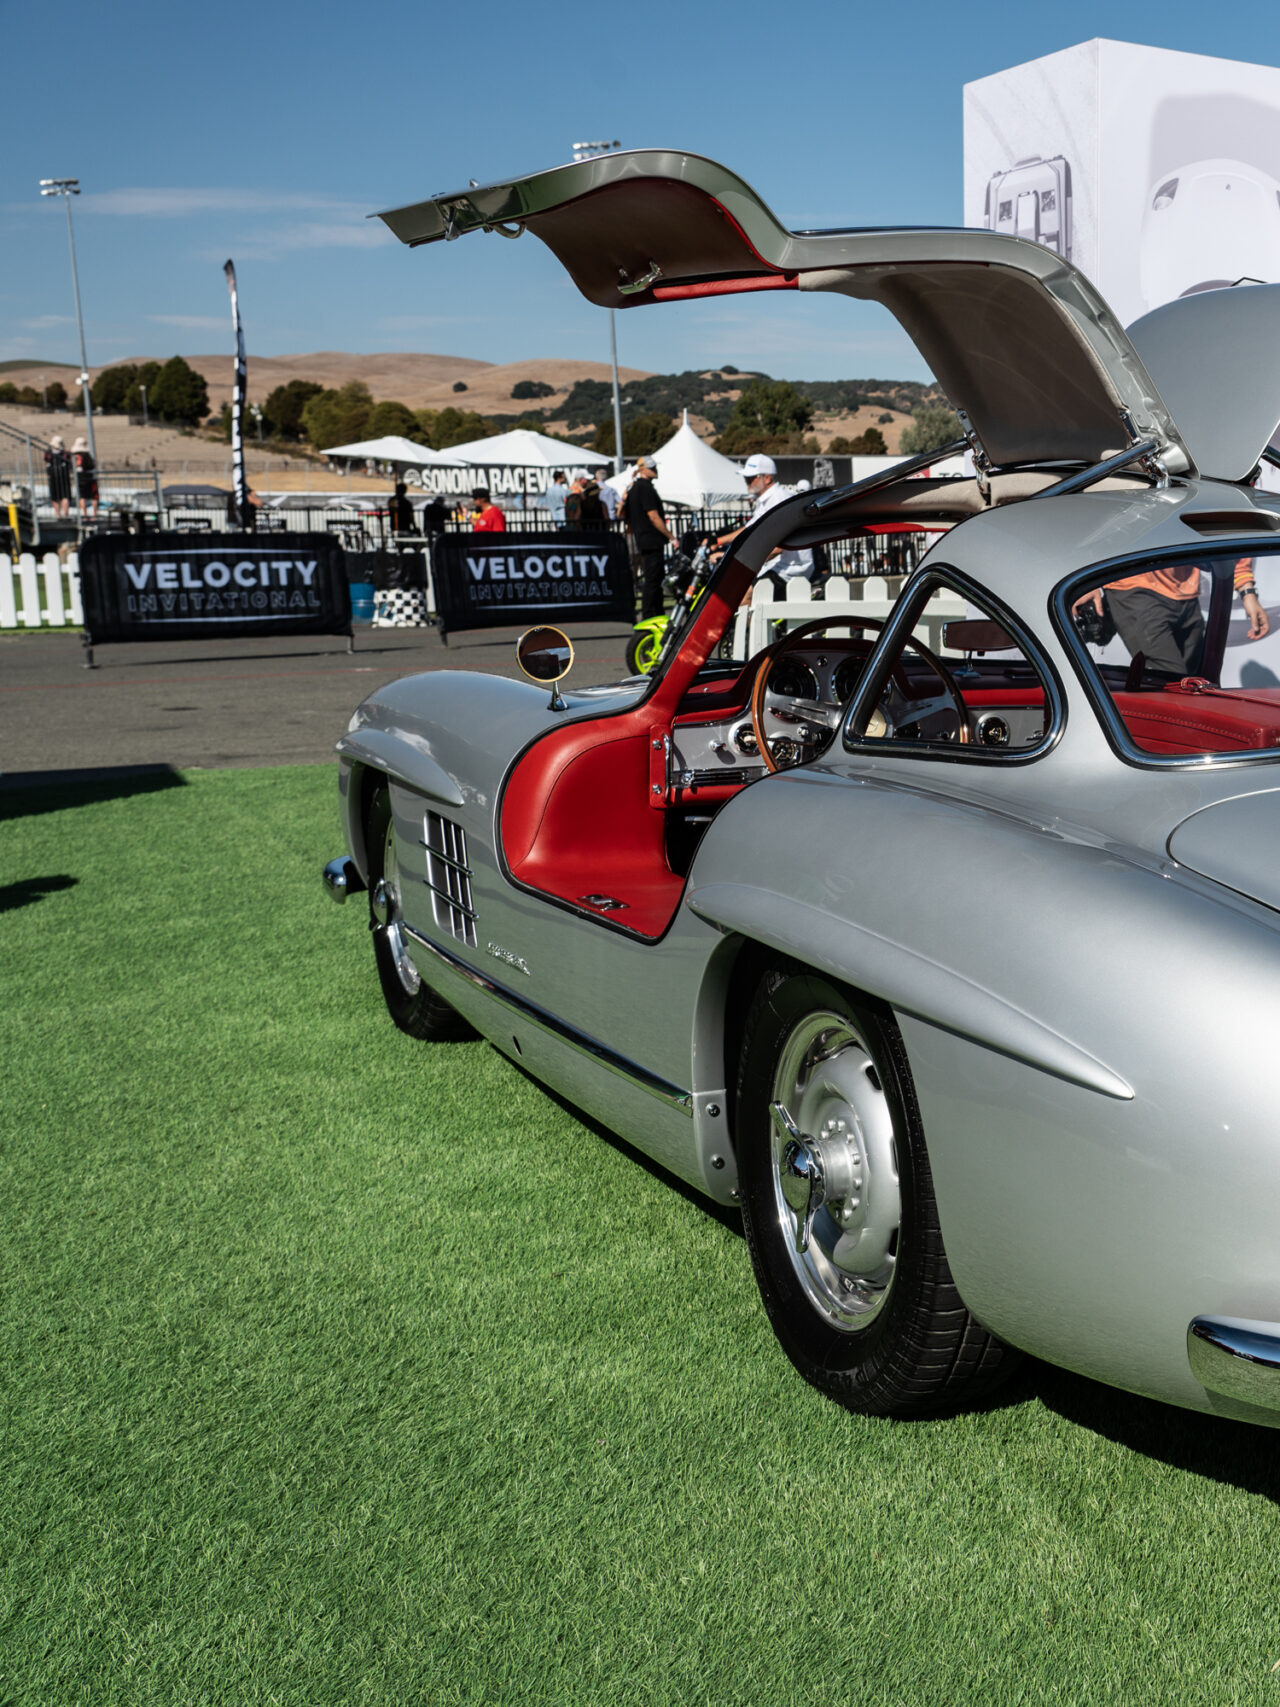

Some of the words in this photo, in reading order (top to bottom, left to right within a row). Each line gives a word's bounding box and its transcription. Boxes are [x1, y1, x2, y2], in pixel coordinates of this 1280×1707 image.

[422, 468, 489, 493] SONOMA
[490, 467, 578, 493] RACEWY
[124, 561, 318, 590] VELOCITY
[466, 554, 609, 580] VELOCITY
[128, 590, 320, 612] INVITATIONAL
[470, 581, 613, 600] INVITATIONAL
